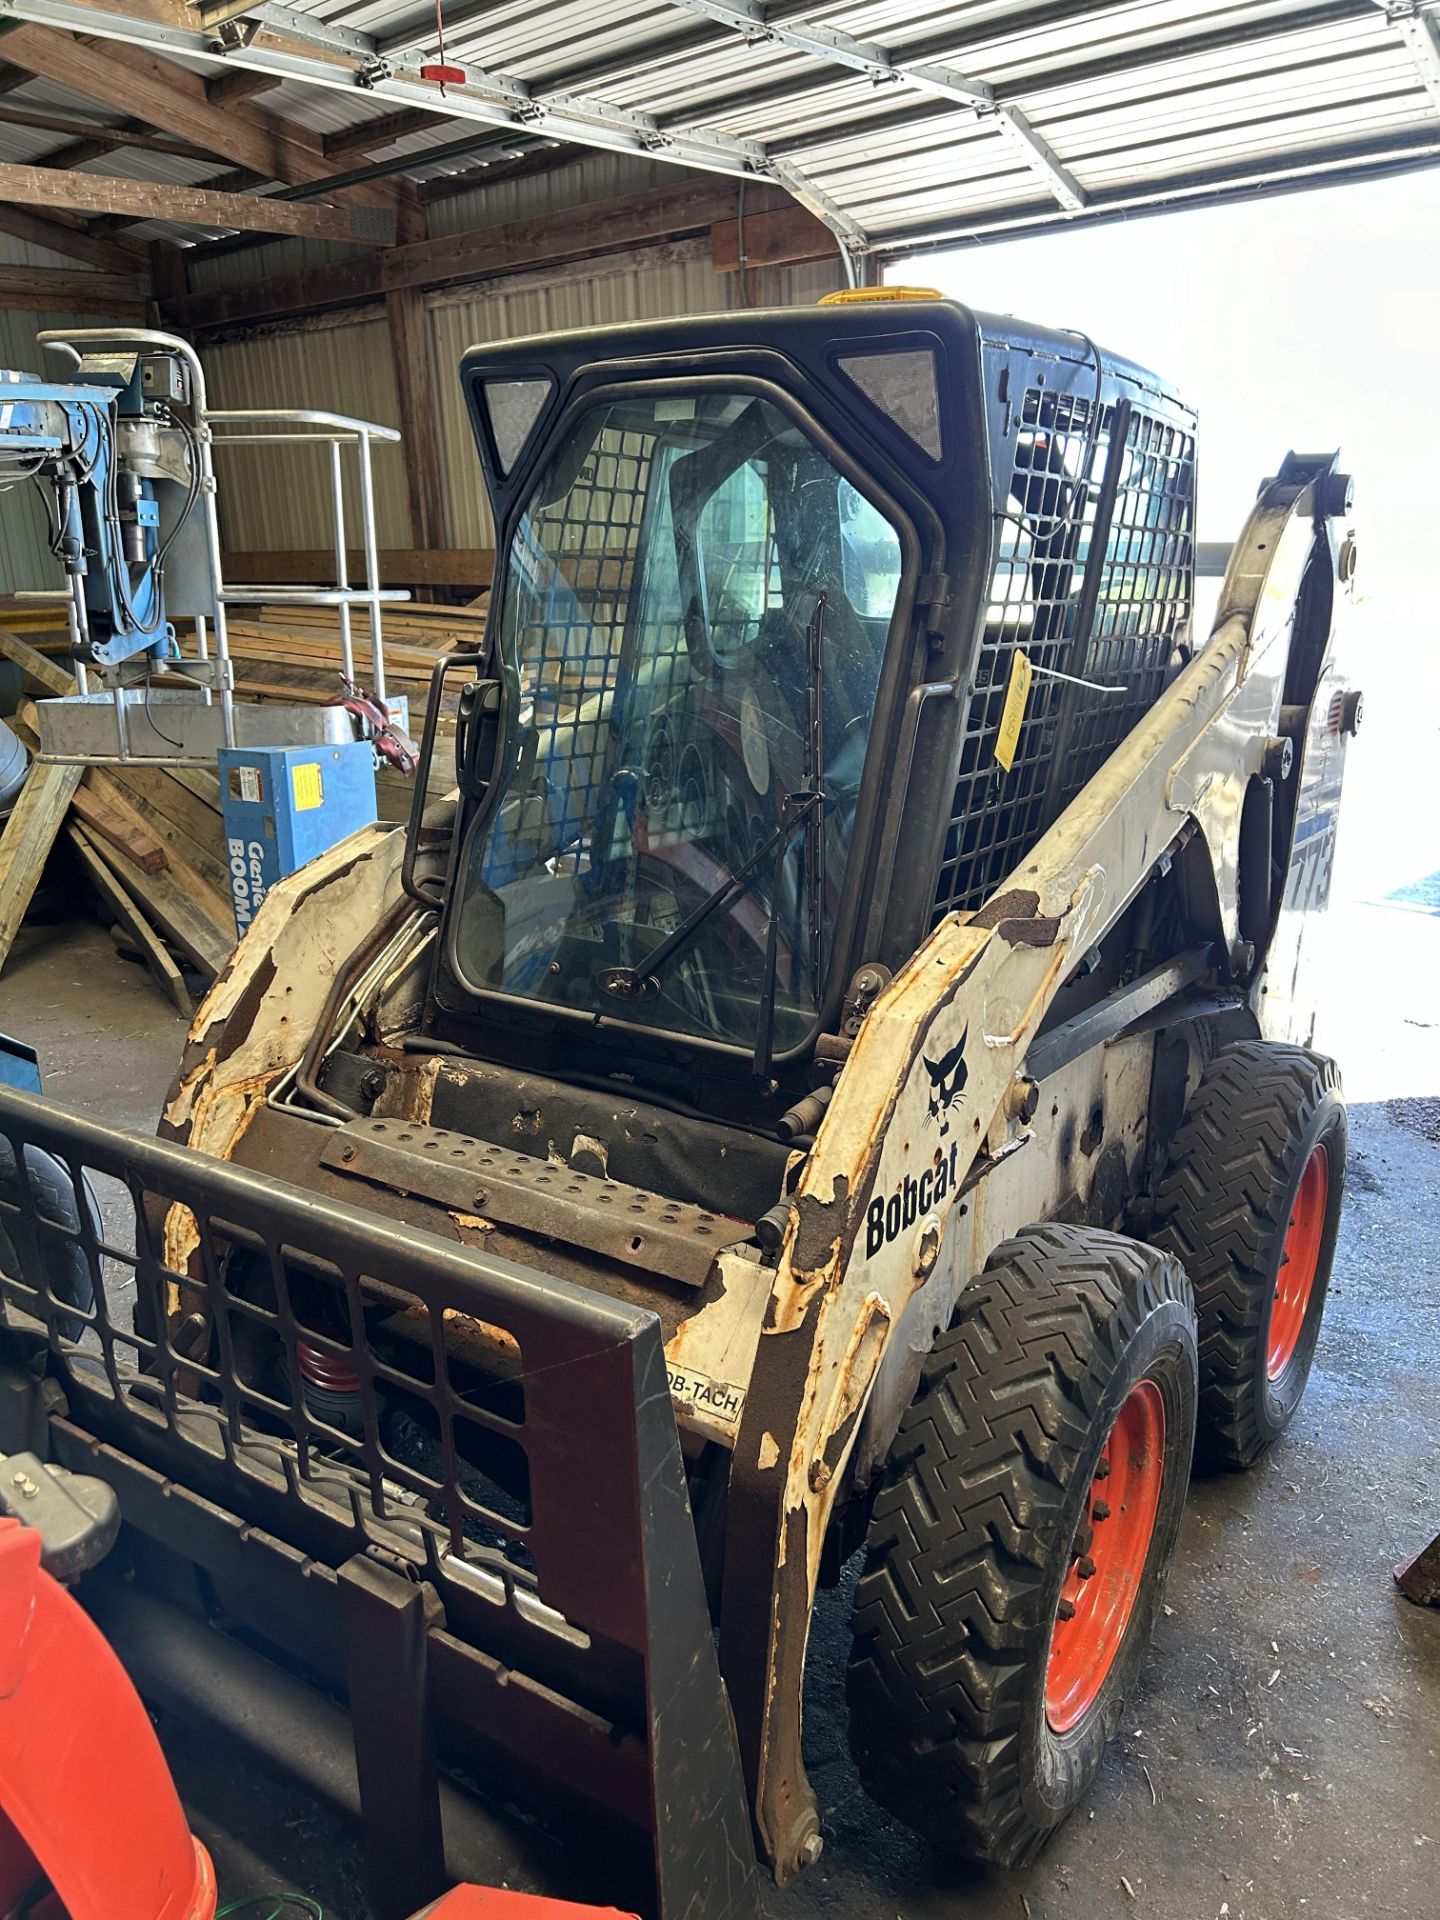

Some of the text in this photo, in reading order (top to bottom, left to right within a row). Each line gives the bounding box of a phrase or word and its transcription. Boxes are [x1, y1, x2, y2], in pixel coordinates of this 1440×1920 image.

[228, 838, 252, 922] BOOM
[247, 841, 267, 908] Genie
[866, 1141, 958, 1261] Bobcat
